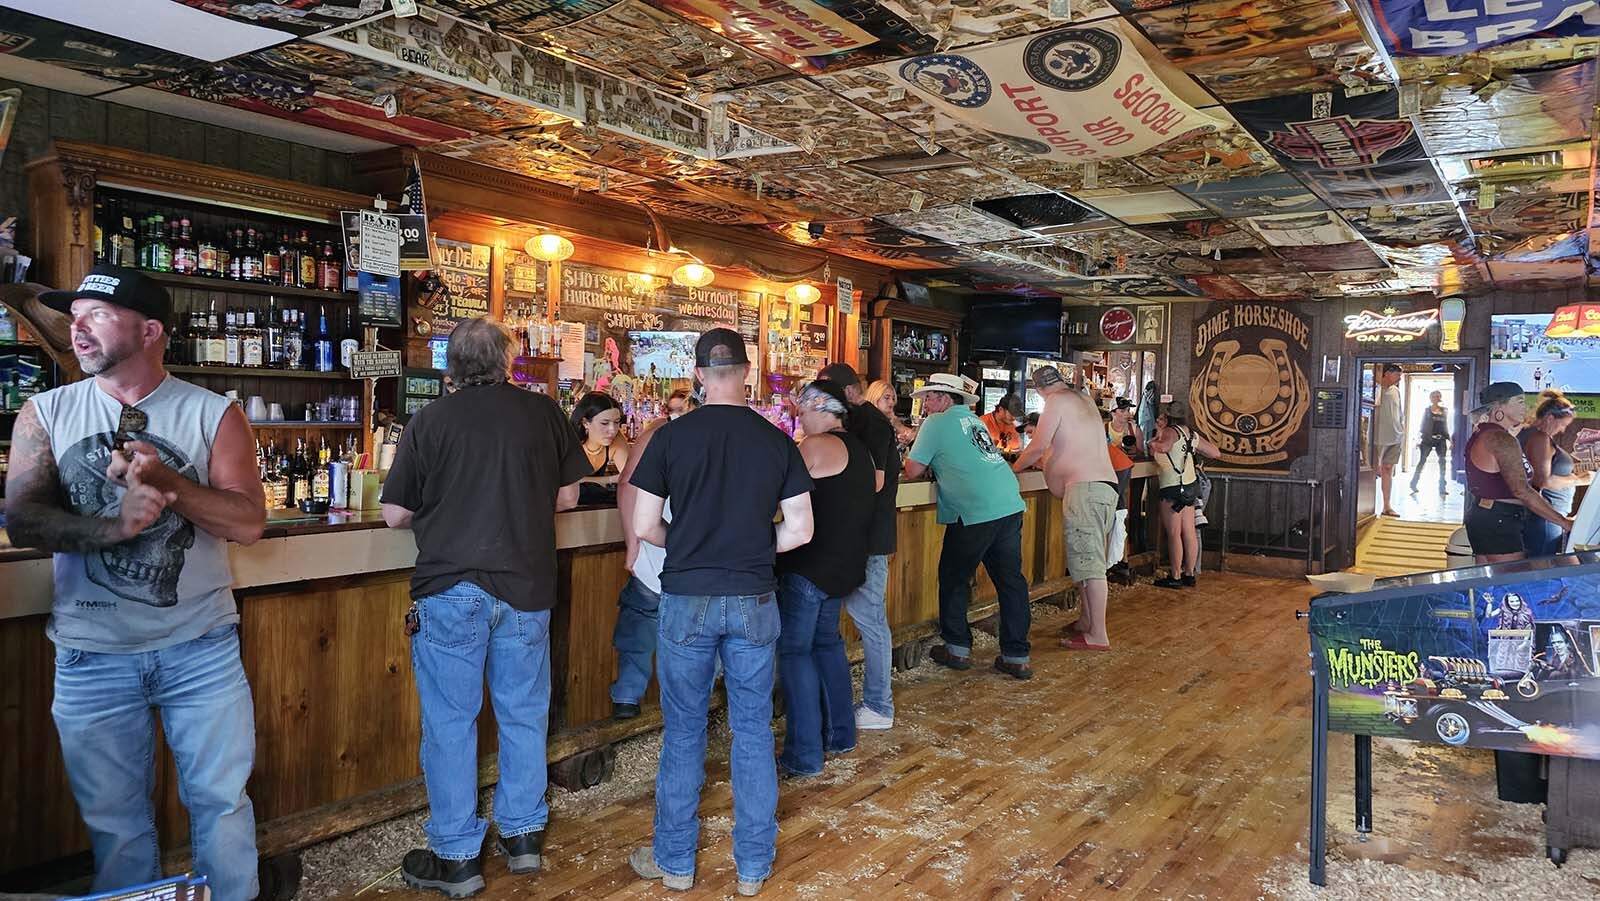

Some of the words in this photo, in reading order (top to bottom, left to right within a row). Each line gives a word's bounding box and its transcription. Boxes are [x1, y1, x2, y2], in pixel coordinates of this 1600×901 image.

[401, 47, 430, 67] BEAR
[1113, 72, 1187, 136] TROOPS
[1000, 82, 1097, 157] SUPPORT
[1082, 115, 1135, 147] OUR
[449, 295, 487, 310] TEQUILA
[564, 288, 637, 312] HURRICANE
[1195, 309, 1230, 357] DIME
[1234, 304, 1309, 350] HORSESHOE
[1344, 314, 1437, 330] Budweiser
[1356, 334, 1380, 342] ON
[1384, 334, 1413, 342] TAP
[1221, 434, 1273, 455] BAR
[70, 482, 86, 493] 45
[1360, 638, 1382, 650] THE
[1327, 648, 1419, 690] MUNSTERS
